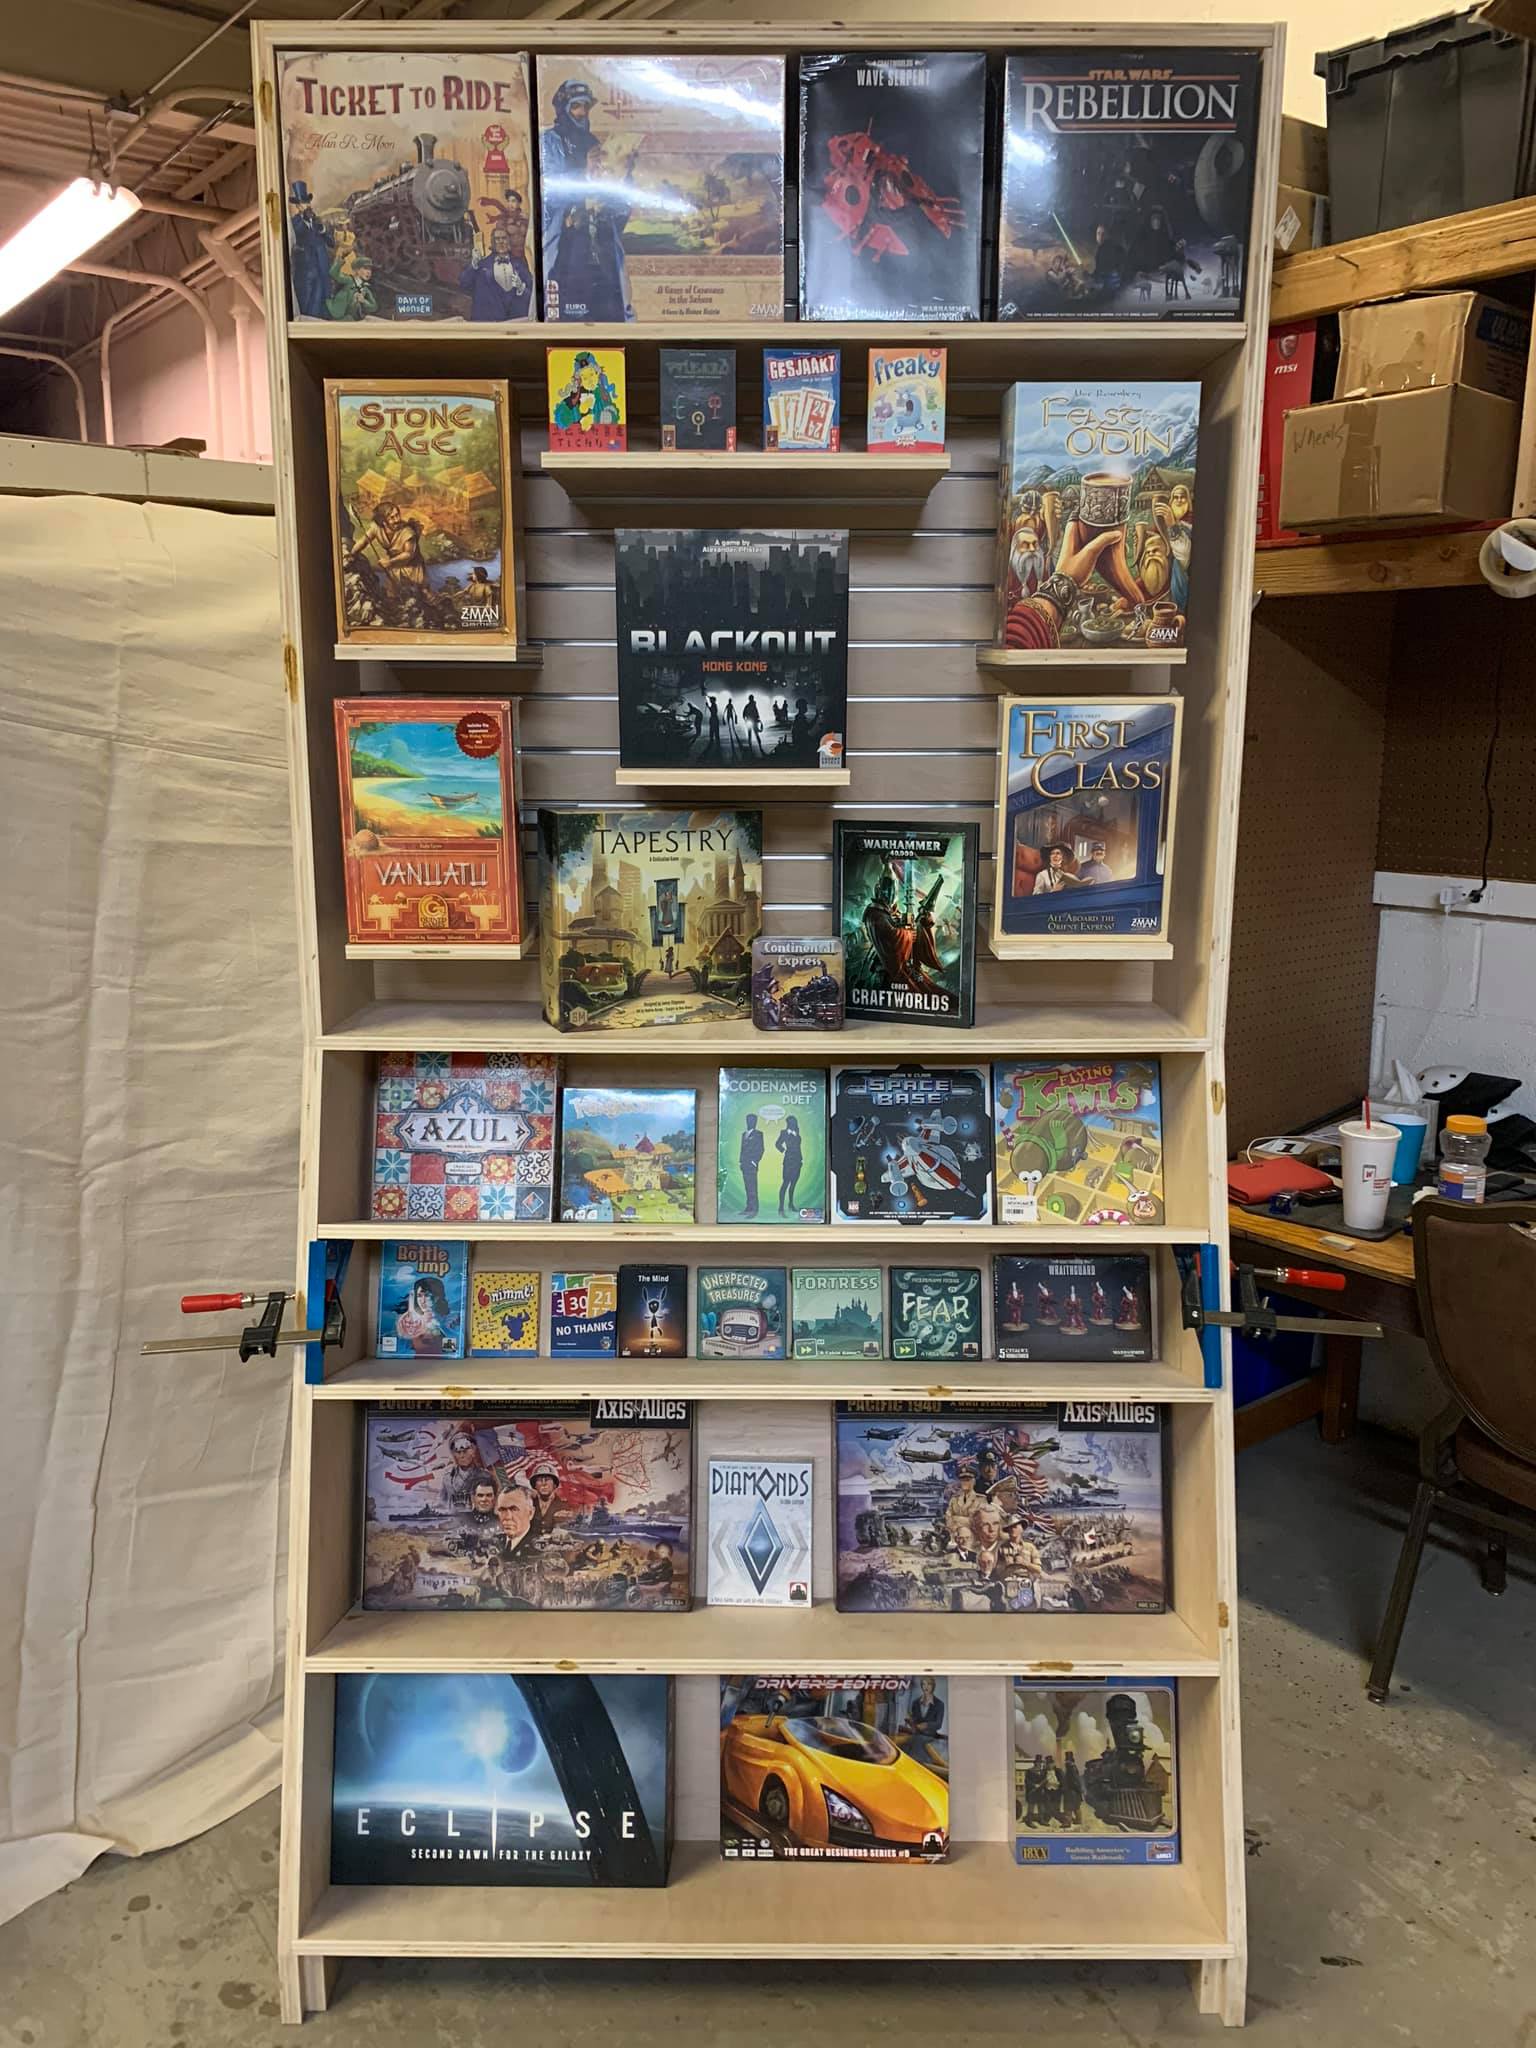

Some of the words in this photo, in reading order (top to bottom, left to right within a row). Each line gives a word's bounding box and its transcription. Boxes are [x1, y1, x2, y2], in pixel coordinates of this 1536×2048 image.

[857, 69, 884, 86] WAVE
[888, 69, 930, 86] SERPENT
[1089, 69, 1125, 80] STAR
[1128, 69, 1173, 80] WARS
[296, 76, 404, 116] TICKET
[409, 87, 436, 109] TO
[443, 76, 512, 113] RIDE
[1022, 83, 1239, 130] REBELLION
[398, 305, 431, 313] WONDER
[769, 355, 836, 380] GESJAAKT
[874, 353, 941, 385] freaky
[1274, 363, 1298, 375] msi
[357, 403, 475, 432] STONE
[813, 401, 826, 419] 24
[376, 430, 458, 457] AGE
[630, 630, 837, 654] BLACKOUT
[703, 661, 733, 672] HONG
[736, 661, 768, 672] KONG
[1020, 711, 1136, 758] FIRST
[1031, 751, 1162, 799] CLASS
[594, 829, 734, 854] TAPESTRY
[863, 839, 941, 850] WARHAMMER
[375, 861, 489, 887] VANUATU
[764, 942, 835, 953] Continental
[778, 955, 821, 967] Express
[852, 988, 950, 1012] CRAFTWORLDS
[1059, 1065, 1114, 1087] FLYING
[729, 1081, 817, 1093] CODENAMES
[869, 1080, 949, 1091] SPACE
[783, 1095, 812, 1105] DUET
[879, 1093, 941, 1105] BASE
[420, 1118, 507, 1141] AZUL
[1048, 1265, 1095, 1276] WRAITHGUARD
[703, 1272, 768, 1291] UNEXPECTED
[796, 1277, 878, 1289] FORTRESS
[478, 1287, 490, 1306] 6
[569, 1296, 587, 1311] 30
[594, 1291, 613, 1305] 21
[710, 1289, 761, 1303] TREASURES
[903, 1292, 970, 1322] FEAR
[556, 1326, 571, 1336] NO
[574, 1321, 614, 1334] THANKS
[596, 1399, 634, 1419] Axis
[639, 1399, 687, 1420] Allies
[1064, 1401, 1102, 1424] Axis
[1107, 1401, 1156, 1424] Allies
[712, 1468, 809, 1502] DIAMONDS
[755, 1679, 836, 1689] DRIVER'S
[842, 1679, 911, 1690] EDITION
[411, 1849, 453, 1859] SECOND
[459, 1849, 488, 1860] DAWN
[500, 1850, 518, 1860] FOR
[526, 1850, 544, 1860] THE
[550, 1850, 592, 1861] GALAXY
[784, 1848, 798, 1856] THE
[800, 1848, 824, 1857] GREAT
[826, 1848, 868, 1858] DESIGNERS
[870, 1849, 896, 1858] SERIES
